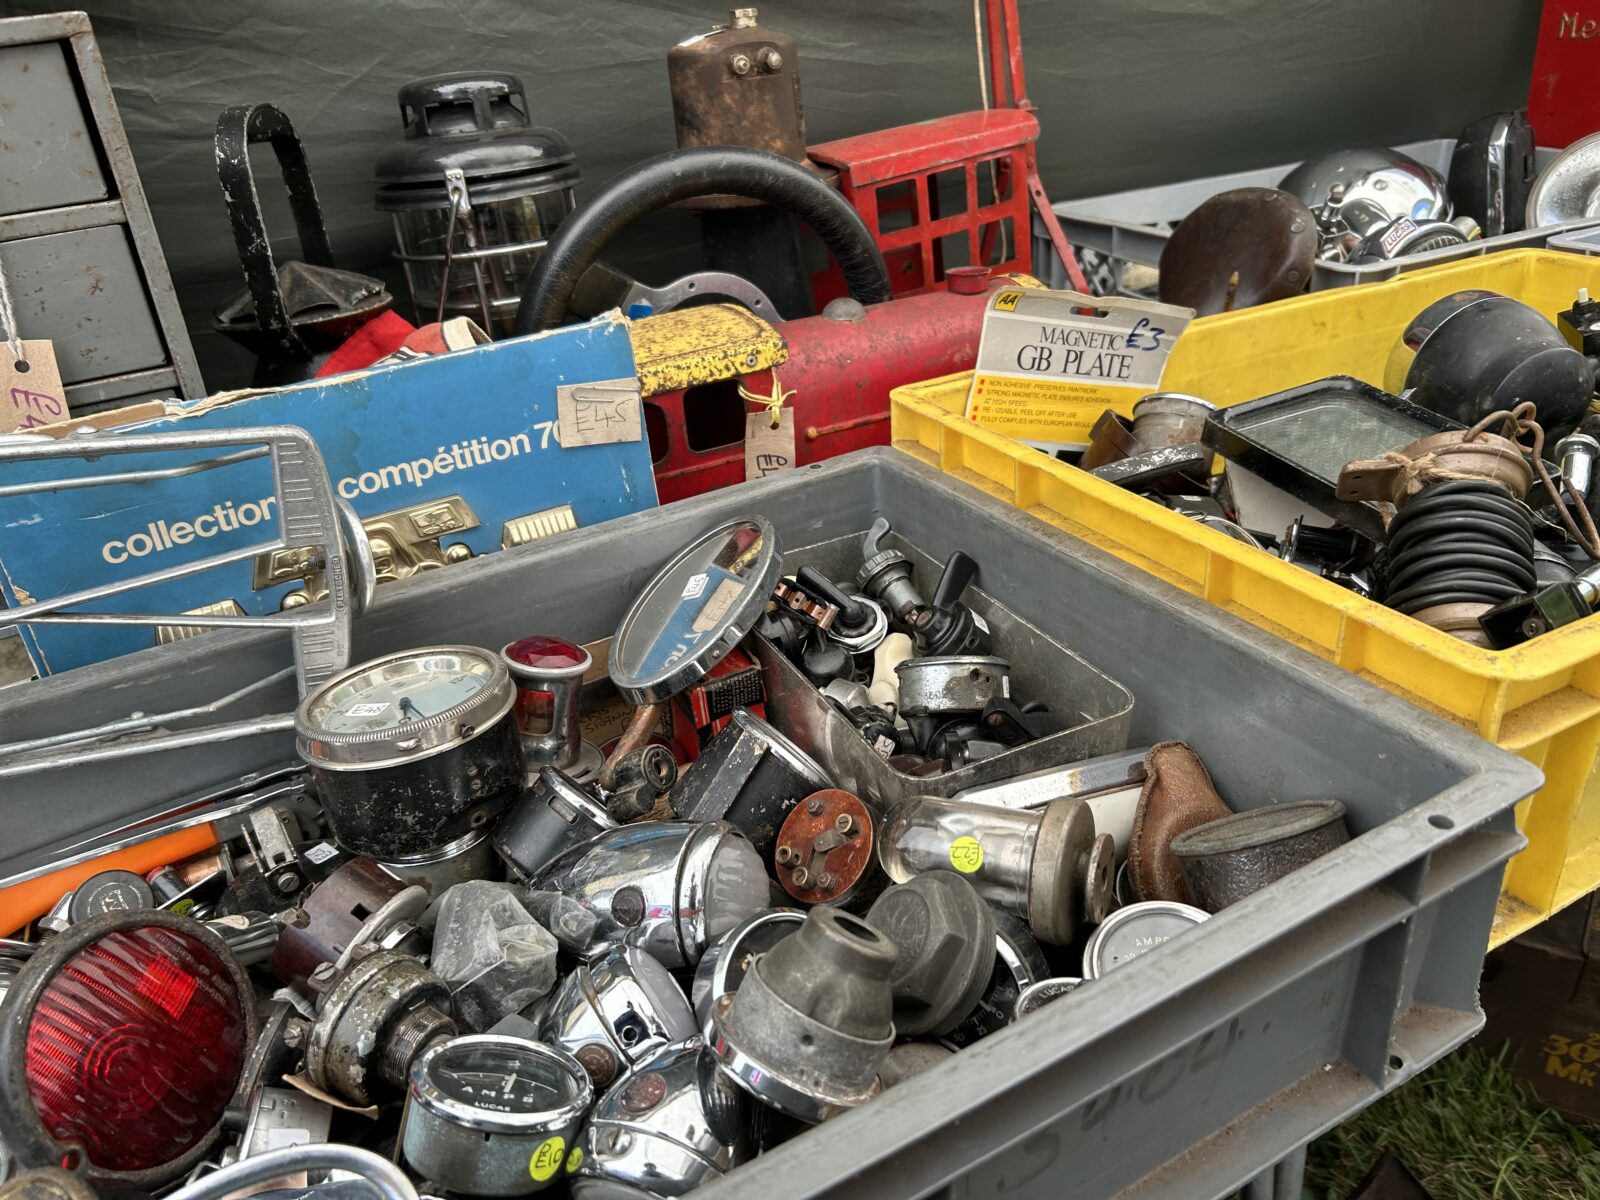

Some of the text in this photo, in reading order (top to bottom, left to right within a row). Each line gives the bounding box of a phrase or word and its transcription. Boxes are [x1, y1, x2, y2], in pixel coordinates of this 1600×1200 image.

[1000, 294, 1019, 306] AA
[1039, 326, 1124, 350] MAGNETIC
[1125, 317, 1166, 351] £3
[1017, 344, 1134, 380] GB PLATE
[989, 380, 1003, 388] NON
[1011, 391, 1041, 400] MAGNETIC
[338, 433, 532, 499] compétition
[474, 1101, 511, 1112] LUCAS
